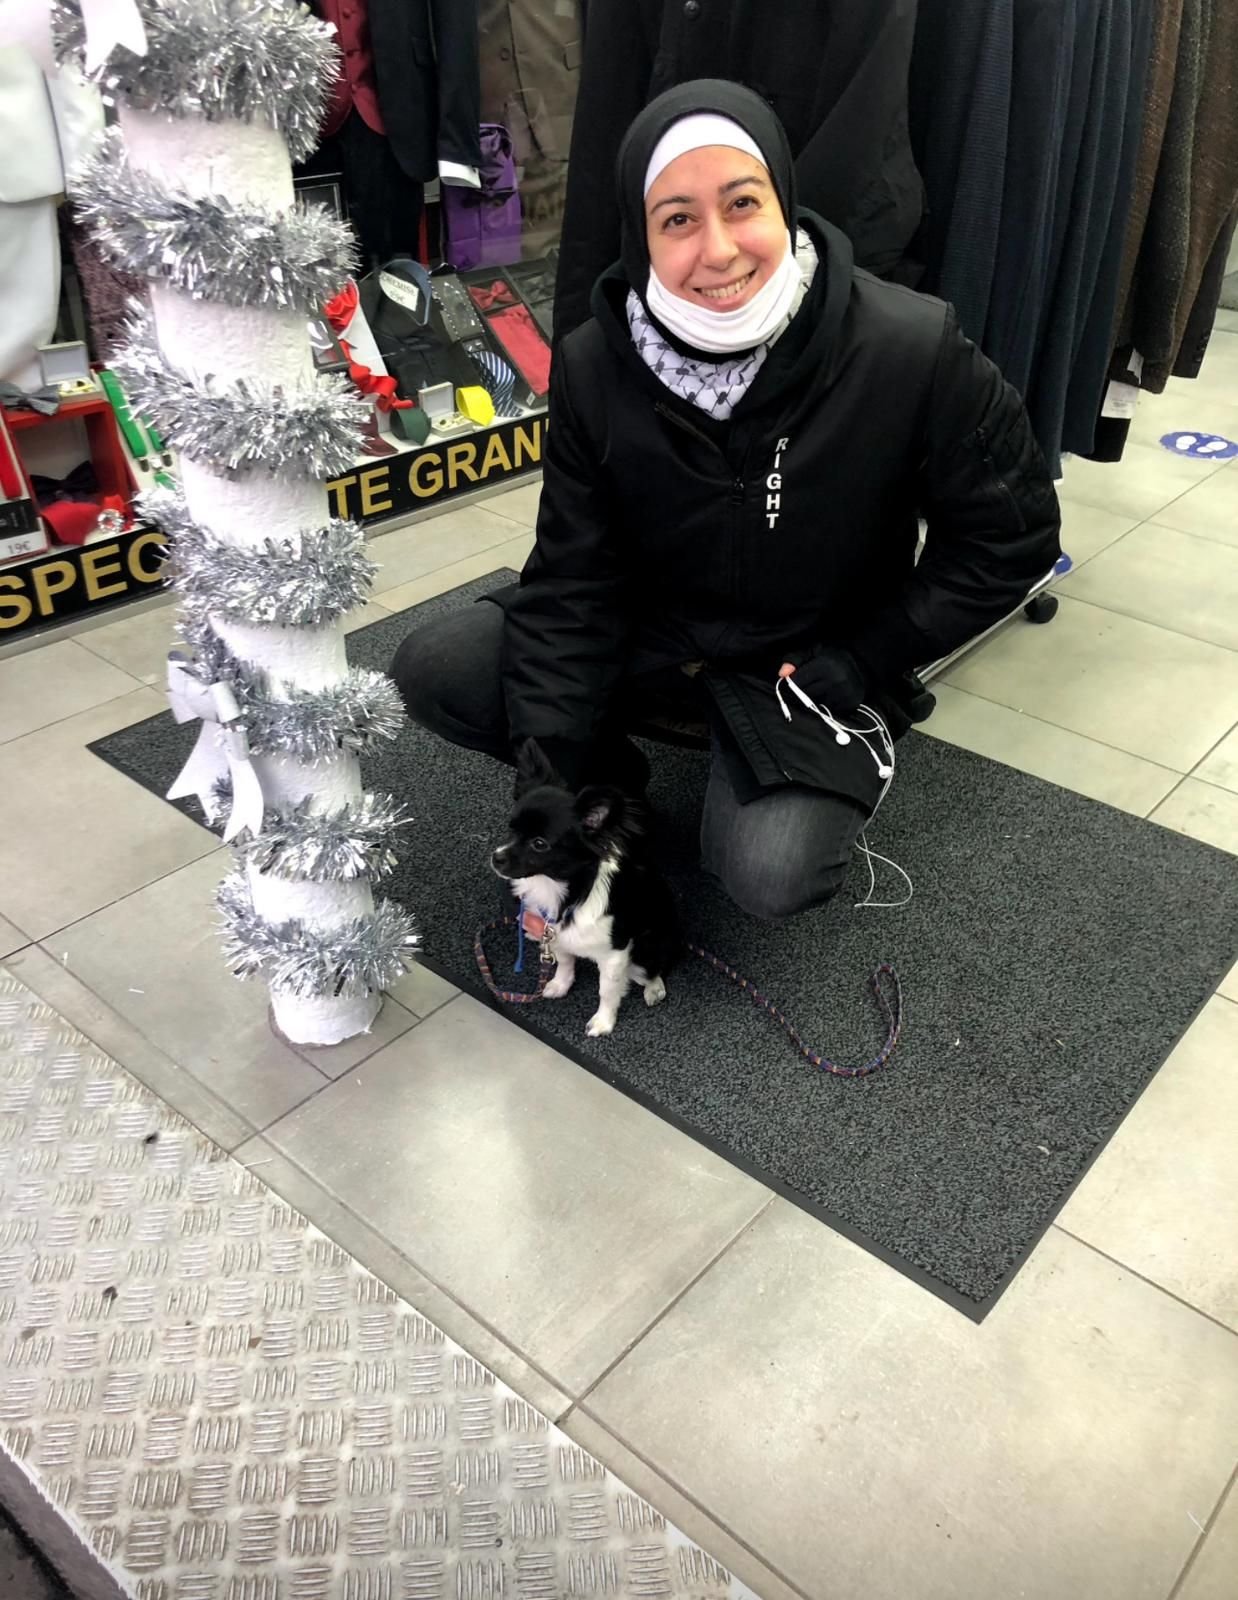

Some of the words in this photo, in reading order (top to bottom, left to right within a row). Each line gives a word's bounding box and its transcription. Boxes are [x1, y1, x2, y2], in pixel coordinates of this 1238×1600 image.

[0, 532, 170, 629] SPEC
[325, 465, 393, 522] TE
[408, 418, 550, 498] GRAN
[765, 437, 790, 529] RIGHT
